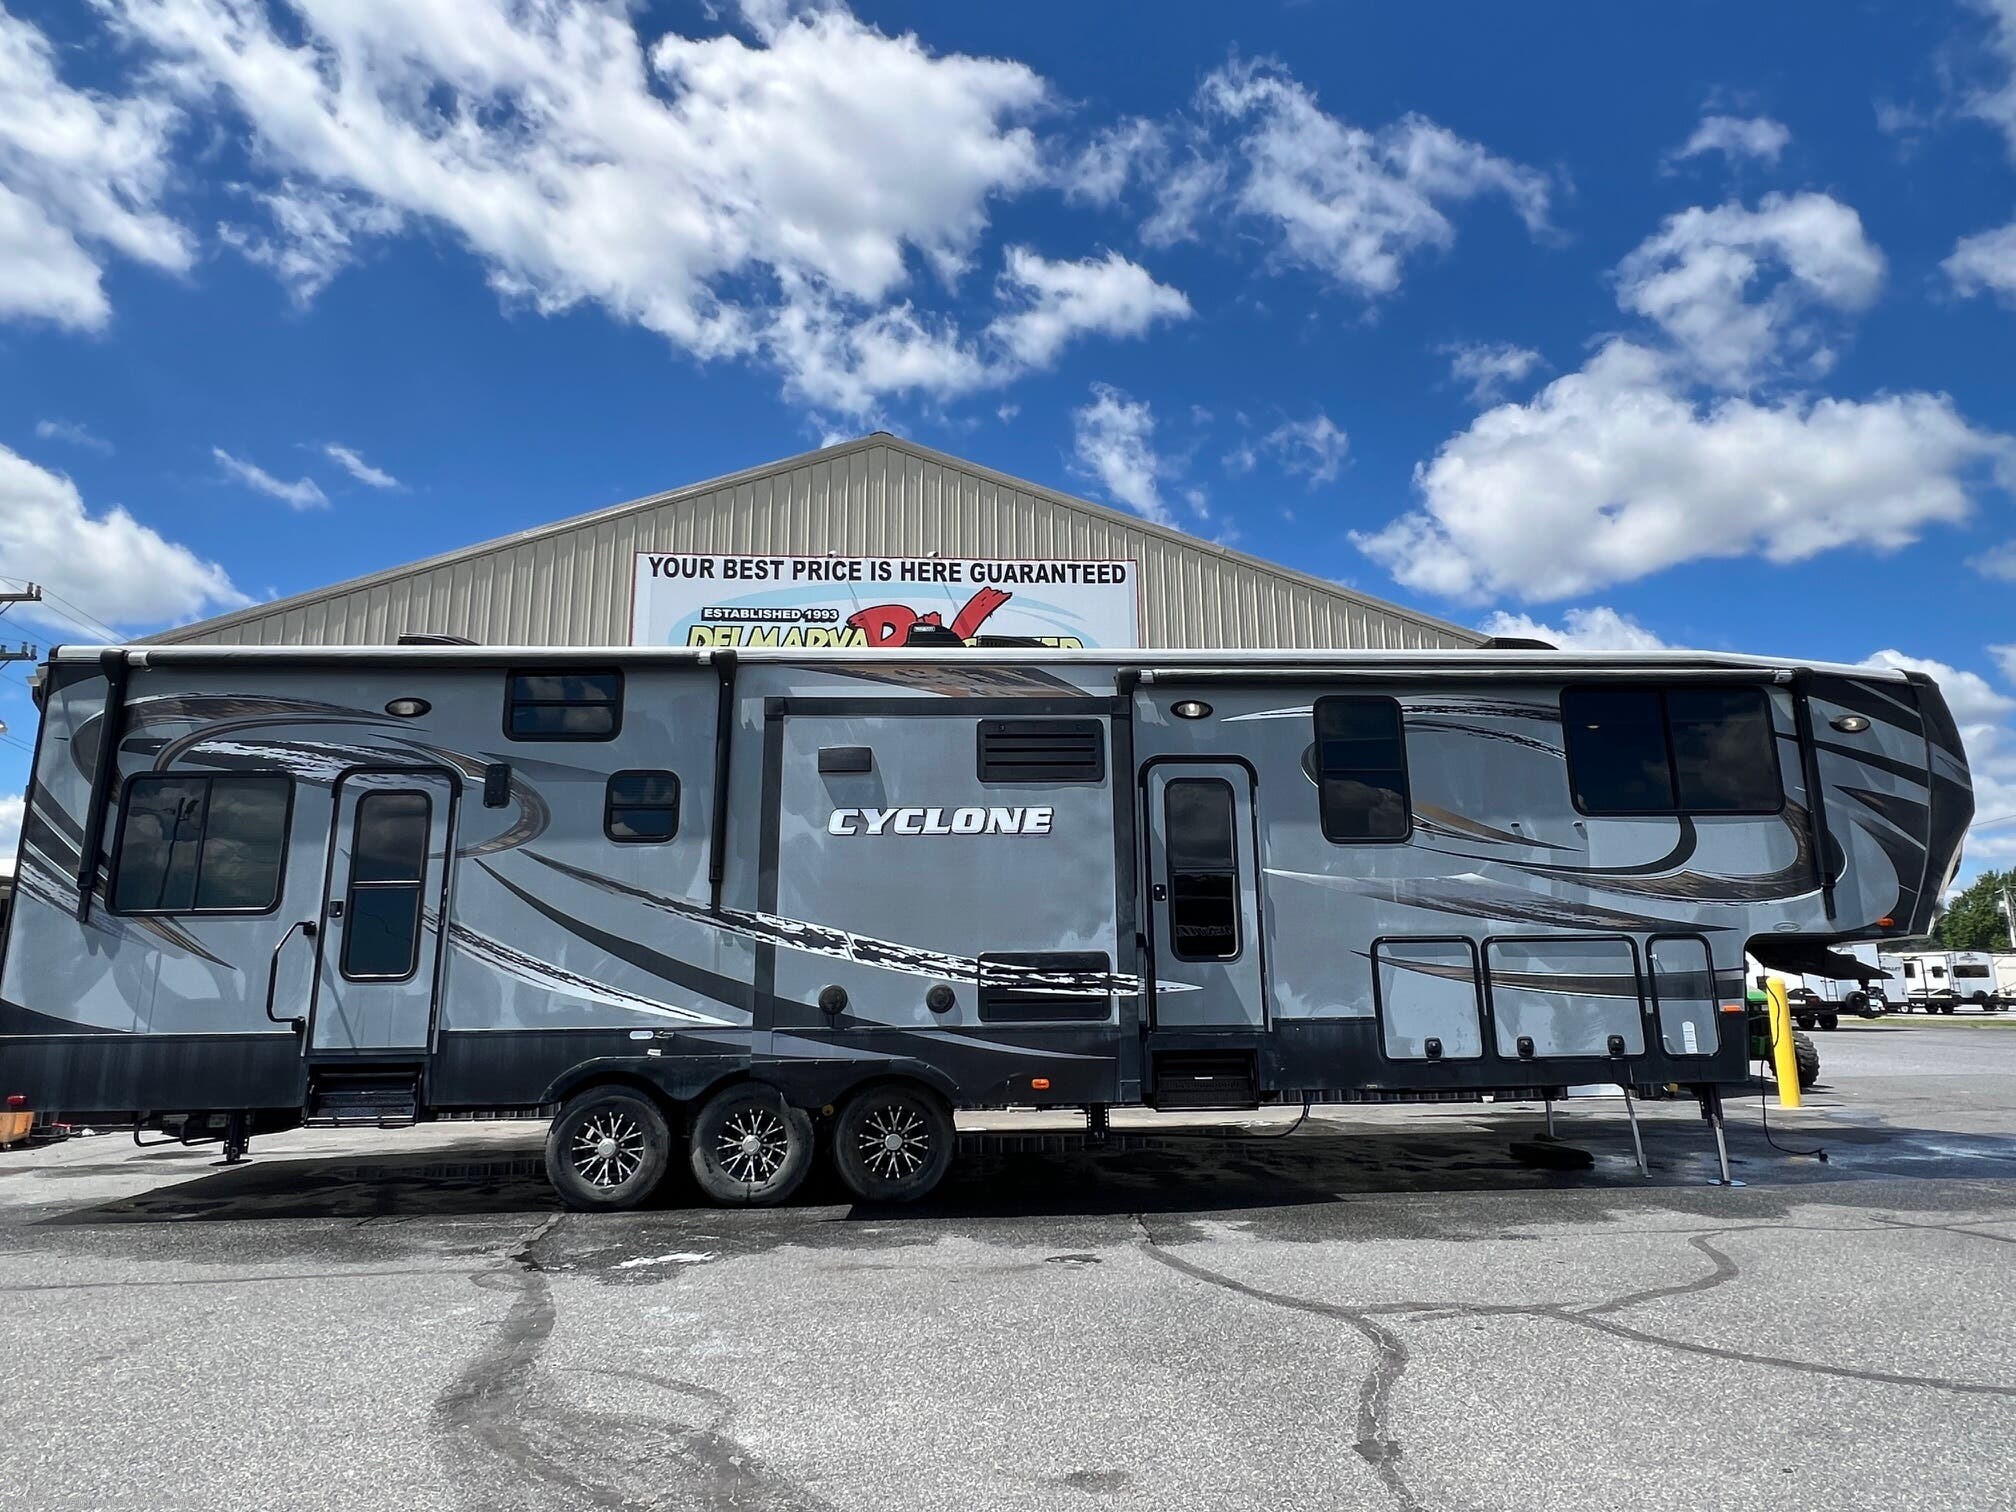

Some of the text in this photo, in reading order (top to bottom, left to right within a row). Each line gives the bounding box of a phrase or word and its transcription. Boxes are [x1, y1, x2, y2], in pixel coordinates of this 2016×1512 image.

[649, 556, 1126, 584] YOUR BEST PRICE IS HERE GUARANTEED
[703, 608, 838, 621] ESTABLISHED 1993
[827, 807, 1054, 836] CYCLONE
